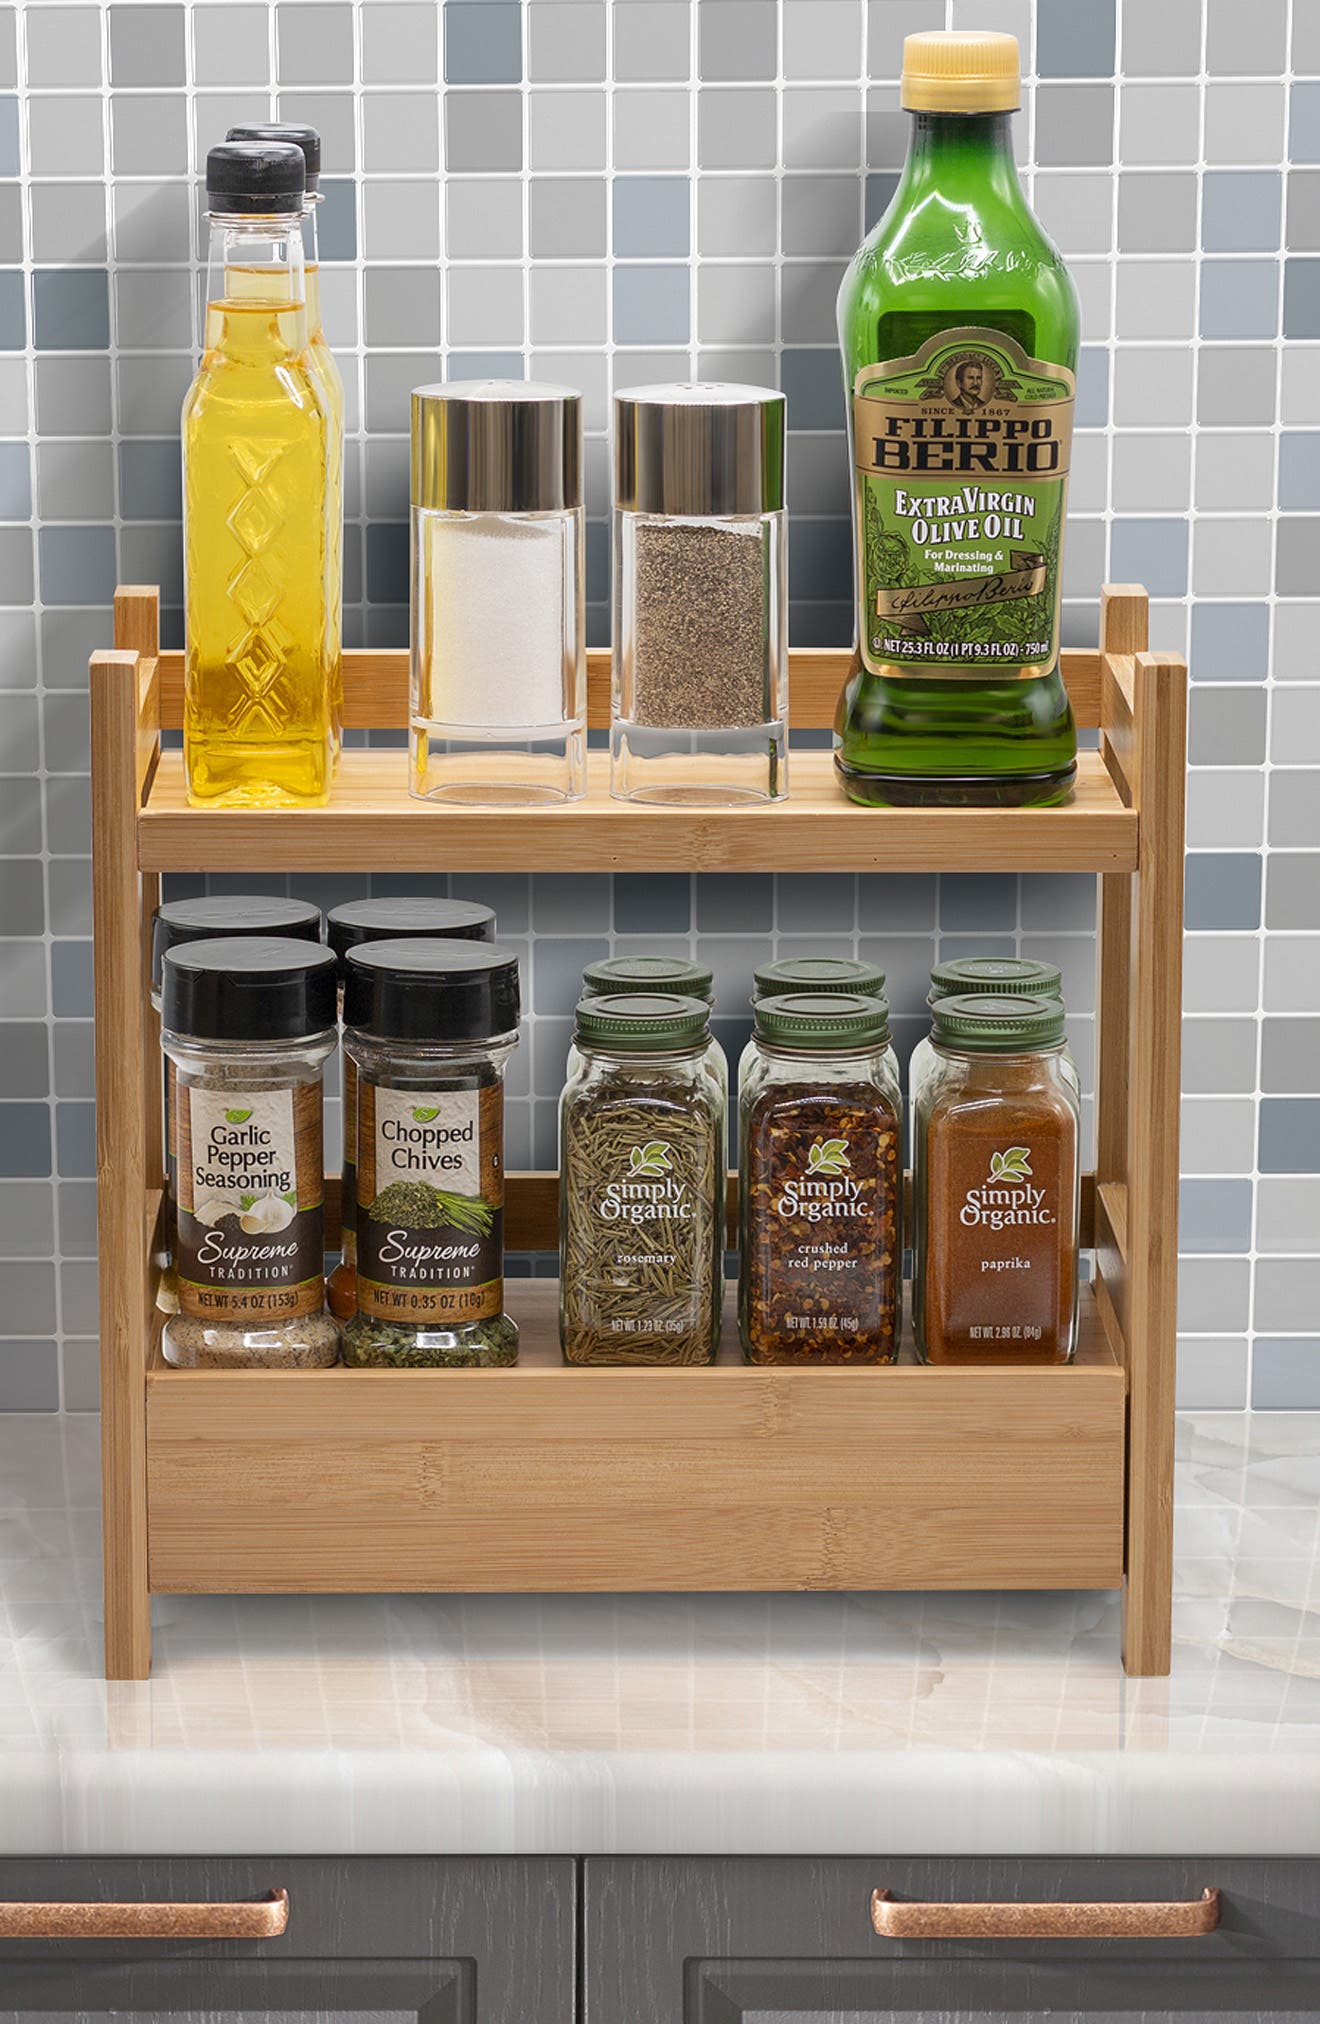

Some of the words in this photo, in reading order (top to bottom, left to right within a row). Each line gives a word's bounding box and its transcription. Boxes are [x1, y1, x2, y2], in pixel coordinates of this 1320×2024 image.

[921, 407, 955, 415] SINCE
[982, 408, 1011, 416] 1867
[885, 416, 1053, 440] FILIPPO
[872, 437, 1060, 473] BERIO
[911, 518, 980, 545] OLIVE
[983, 514, 1024, 540] OIL
[925, 549, 943, 560] For
[945, 550, 993, 562] Dressing
[994, 551, 1004, 560] &
[934, 562, 994, 574] Marinating
[884, 638, 901, 652] NET
[902, 640, 923, 654] 25.3
[924, 643, 935, 655] FL
[937, 643, 950, 655] OZ
[950, 643, 959, 657] (1
[961, 643, 974, 656] PT
[975, 643, 990, 656] 9.3
[991, 643, 1002, 656] FL
[1003, 643, 1019, 657] OZ)
[211, 1125, 271, 1146] Garlic
[381, 1120, 474, 1149] Chopped
[207, 1145, 277, 1172] Pepper
[391, 1148, 463, 1170] Chives
[196, 1166, 291, 1192] Seasoning
[783, 1176, 864, 1202] Simply
[606, 1178, 686, 1204] Simply
[966, 1184, 1046, 1210] Simply
[600, 1198, 692, 1225] Organic
[777, 1196, 869, 1223] Organic
[960, 1204, 1051, 1231] Organic
[197, 1231, 299, 1268] Supreme
[378, 1230, 481, 1268] Supreme
[798, 1242, 849, 1254] crushed
[617, 1253, 678, 1266] rosemary
[788, 1257, 809, 1268] red
[813, 1258, 858, 1271] pepper
[981, 1257, 1031, 1272] paprika
[209, 1265, 290, 1280] TRADITION
[391, 1265, 470, 1280] TRADITION
[198, 1292, 212, 1306] NET
[214, 1295, 229, 1308] WT
[232, 1295, 248, 1309] 5.4
[250, 1295, 265, 1309] OZ
[268, 1291, 299, 1310] (153g)
[374, 1290, 390, 1305] NET
[393, 1293, 408, 1308] WT
[410, 1295, 437, 1309] 0.35
[440, 1295, 455, 1309] OZ
[459, 1291, 486, 1309] (10g)
[611, 1319, 624, 1332] NET
[638, 1319, 653, 1332] 1.23
[786, 1316, 798, 1329] NET
[840, 1317, 859, 1332] (45g)
[969, 1326, 982, 1339] NET
